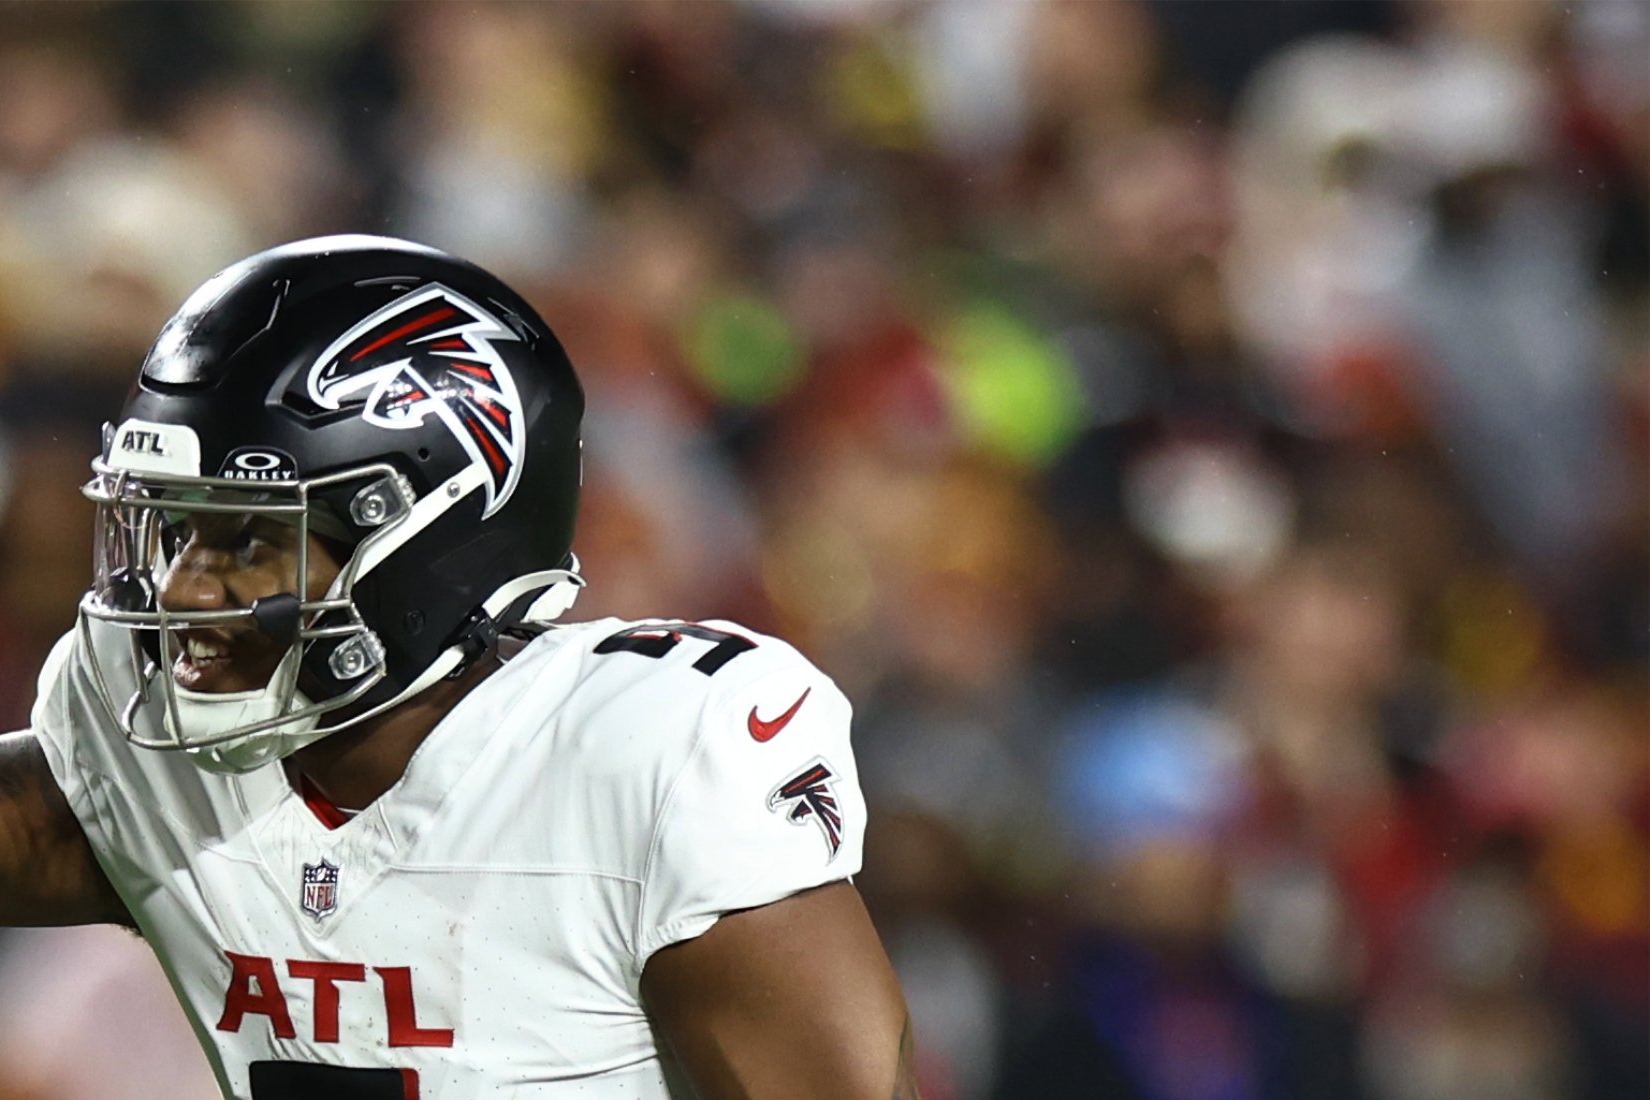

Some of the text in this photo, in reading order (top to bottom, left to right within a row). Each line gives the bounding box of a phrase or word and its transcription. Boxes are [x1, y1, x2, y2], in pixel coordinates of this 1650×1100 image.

[121, 430, 165, 456] ATL
[223, 470, 292, 480] OAKLEY
[306, 885, 333, 909] NFL
[216, 950, 455, 1048] ATL
